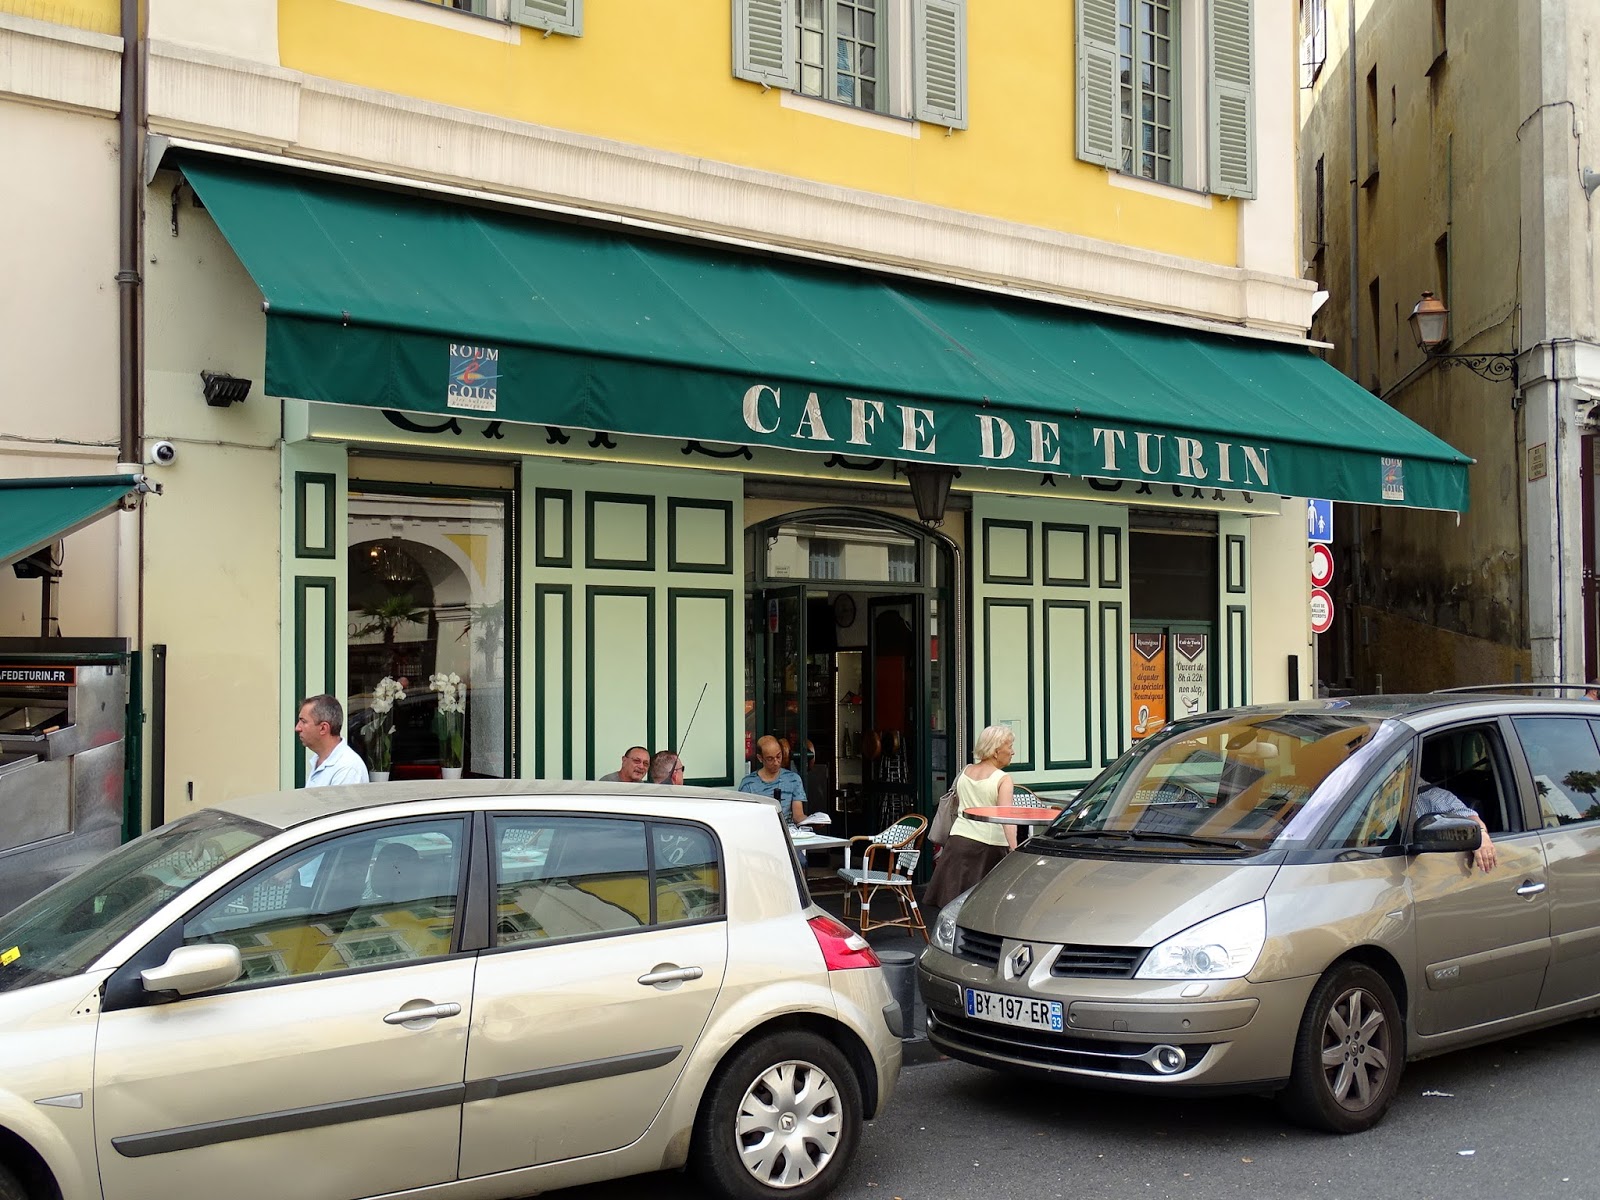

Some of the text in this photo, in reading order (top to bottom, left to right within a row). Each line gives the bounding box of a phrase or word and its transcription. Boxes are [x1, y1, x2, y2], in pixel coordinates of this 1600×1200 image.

[449, 343, 499, 361] ROUM
[448, 384, 497, 400] GOUS
[742, 383, 1271, 487] CAFE DE TURIN
[0, 670, 66, 681] FEDETURIN.FR
[1192, 673, 1203, 682] 22h
[1052, 1017, 1062, 1028] 33
